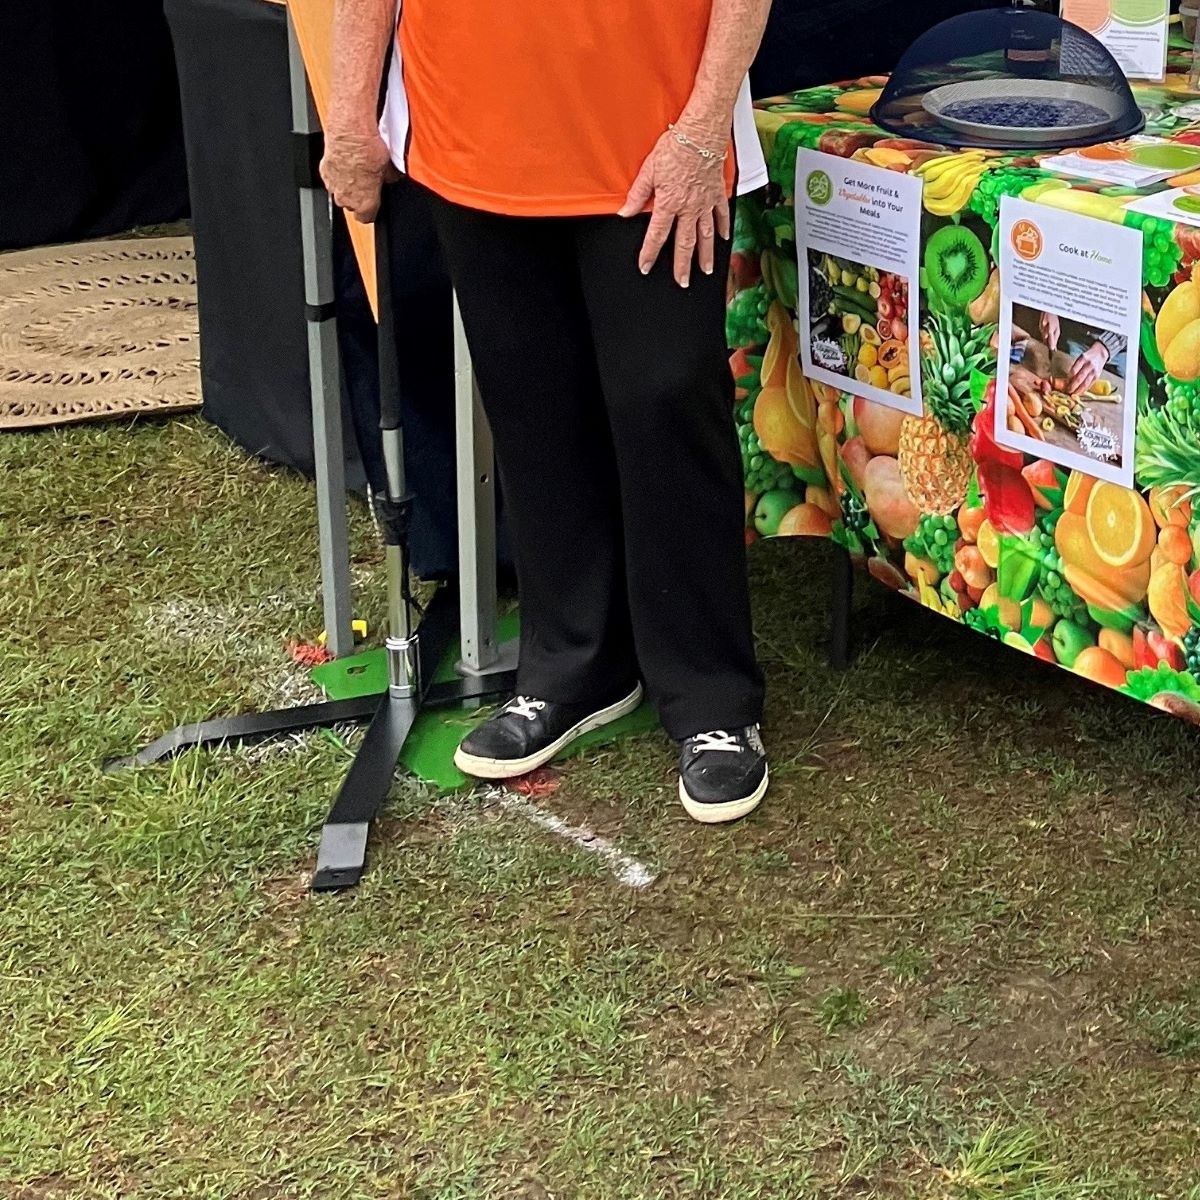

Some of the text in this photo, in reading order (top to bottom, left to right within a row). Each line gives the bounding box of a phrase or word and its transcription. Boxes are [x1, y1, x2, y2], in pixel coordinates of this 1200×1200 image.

[844, 177, 855, 187] Get
[857, 181, 875, 192] More
[877, 186, 893, 196] Fruit
[860, 206, 880, 219] Meals
[872, 197, 885, 208] into
[887, 202, 903, 213] Your
[1059, 243, 1079, 255] Cook
[1081, 250, 1089, 258] at
